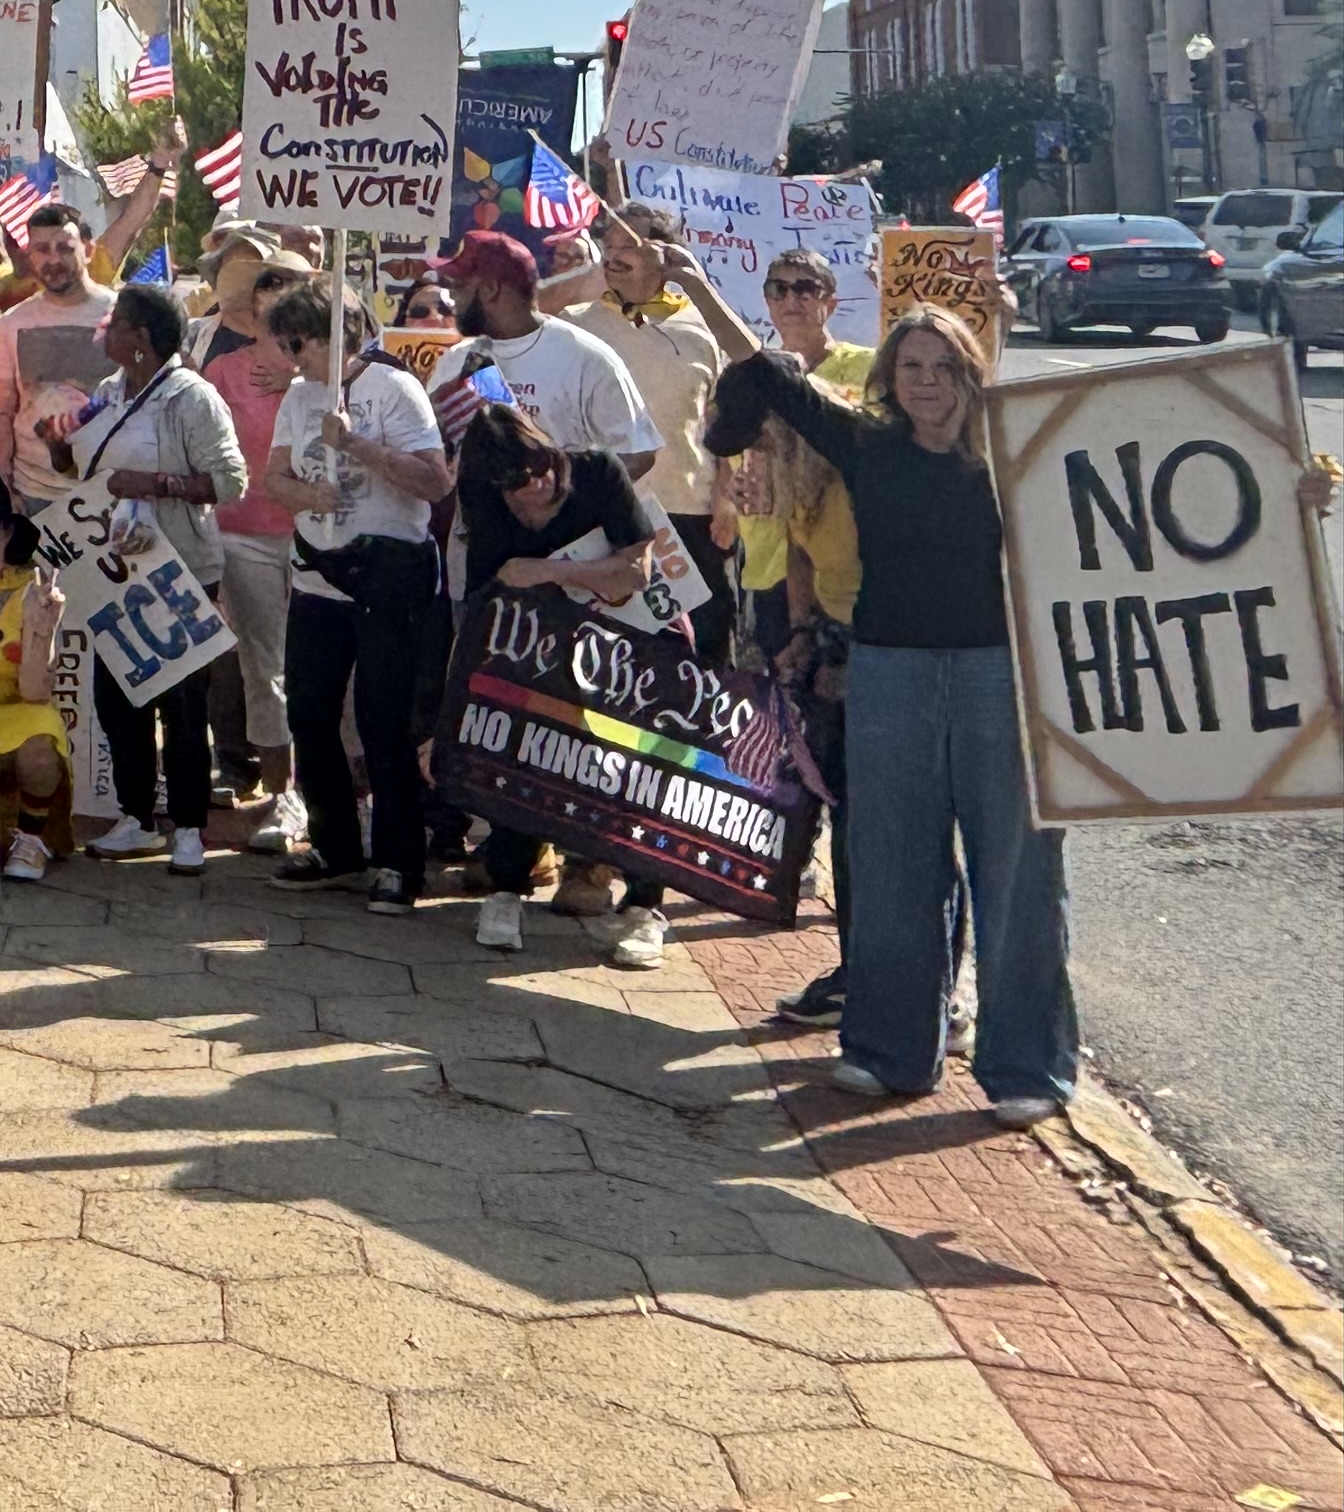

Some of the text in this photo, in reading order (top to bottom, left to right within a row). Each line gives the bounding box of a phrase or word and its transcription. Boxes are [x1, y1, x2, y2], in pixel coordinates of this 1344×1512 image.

[335, 22, 368, 56] IS
[459, 97, 553, 125] AMERICU
[626, 118, 667, 150] US
[256, 169, 319, 209] WE
[1065, 439, 1262, 572] NO
[87, 559, 225, 689] ICE
[485, 596, 560, 679] We
[572, 621, 659, 716] The
[1052, 586, 1300, 734] HATE
[459, 703, 787, 861] NO KINGS IN AMERICA
